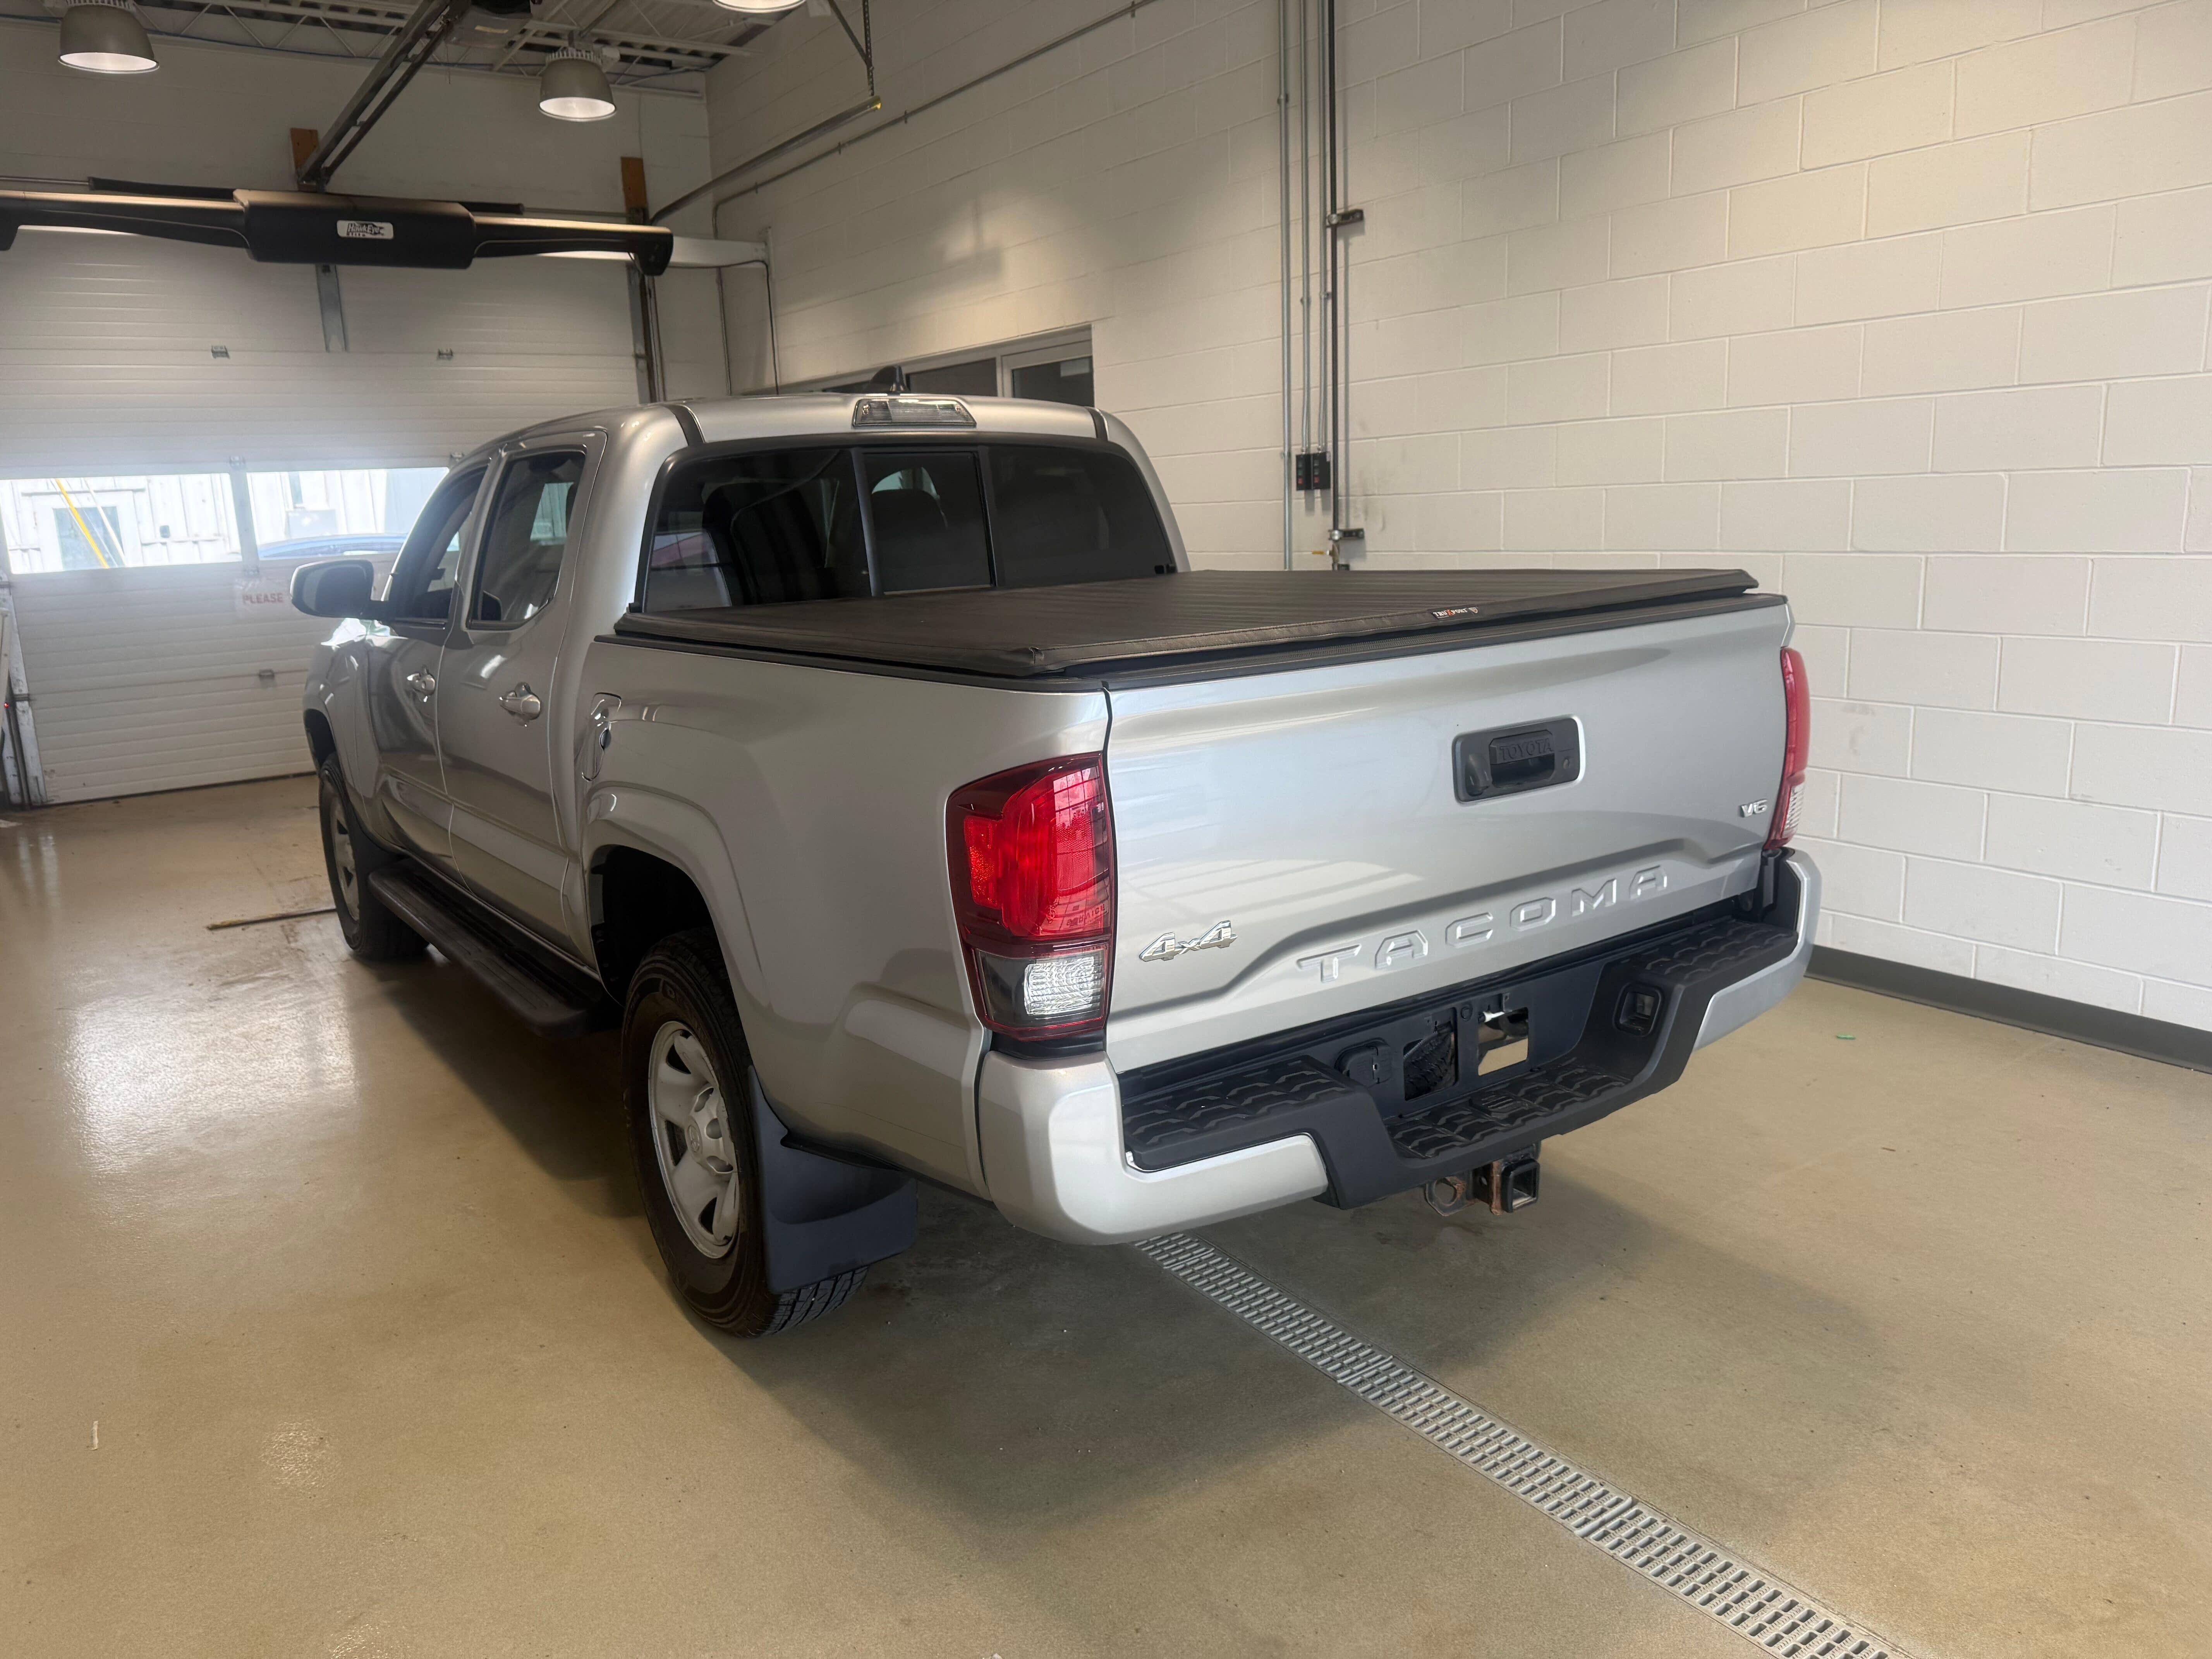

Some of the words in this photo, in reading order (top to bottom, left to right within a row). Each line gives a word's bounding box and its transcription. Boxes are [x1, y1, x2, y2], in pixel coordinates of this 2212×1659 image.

[242, 592, 285, 605] PLEASE
[1433, 608, 1468, 617] TRUXPORT
[1500, 738, 1553, 761] TOYOTA
[1740, 799, 1767, 817] V6
[1296, 865, 1667, 982] TACOMA
